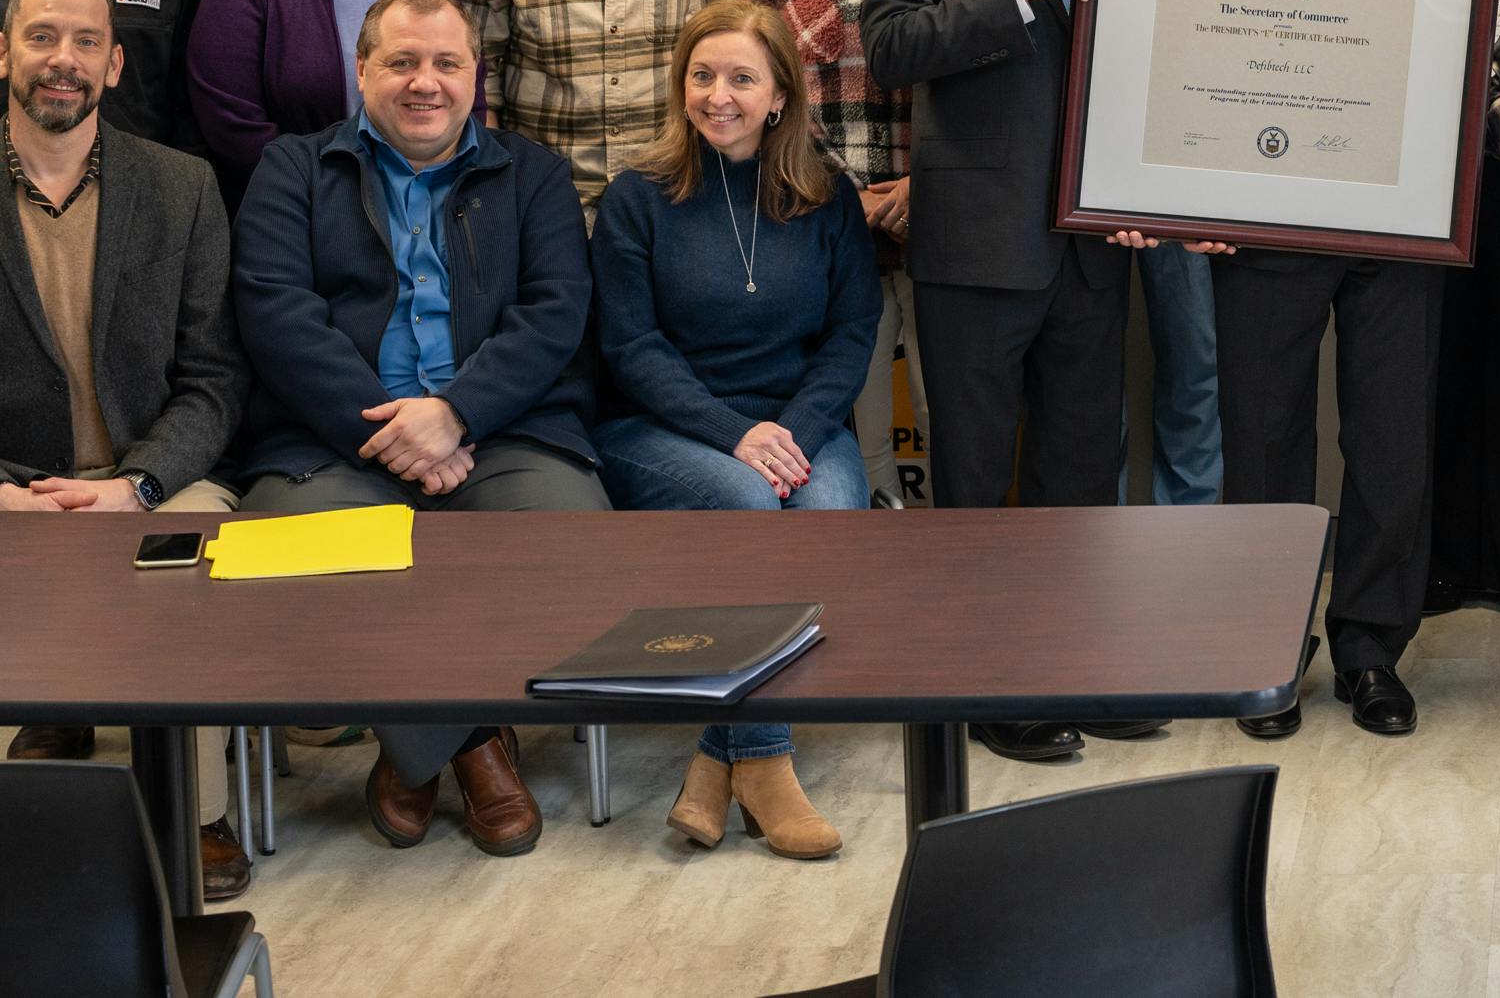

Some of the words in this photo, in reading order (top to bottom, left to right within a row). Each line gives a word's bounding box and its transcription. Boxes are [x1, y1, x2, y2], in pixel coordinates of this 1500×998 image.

[1220, 3, 1238, 14] The
[1241, 6, 1285, 21] Secretary
[1287, 10, 1298, 20] of
[1299, 11, 1349, 24] Commerce
[1195, 23, 1210, 32] The
[1210, 25, 1259, 36] PRESIDENT'S
[1275, 31, 1323, 43] CERTIFICATE
[1324, 35, 1335, 43] for
[1335, 36, 1370, 46] EXPORTS
[1246, 60, 1289, 74] Defibtech
[1294, 64, 1314, 75] LLC
[1207, 88, 1247, 96] outstanding
[1247, 91, 1289, 99] contribution
[1335, 98, 1371, 106] Expansion
[1210, 95, 1239, 103] Program
